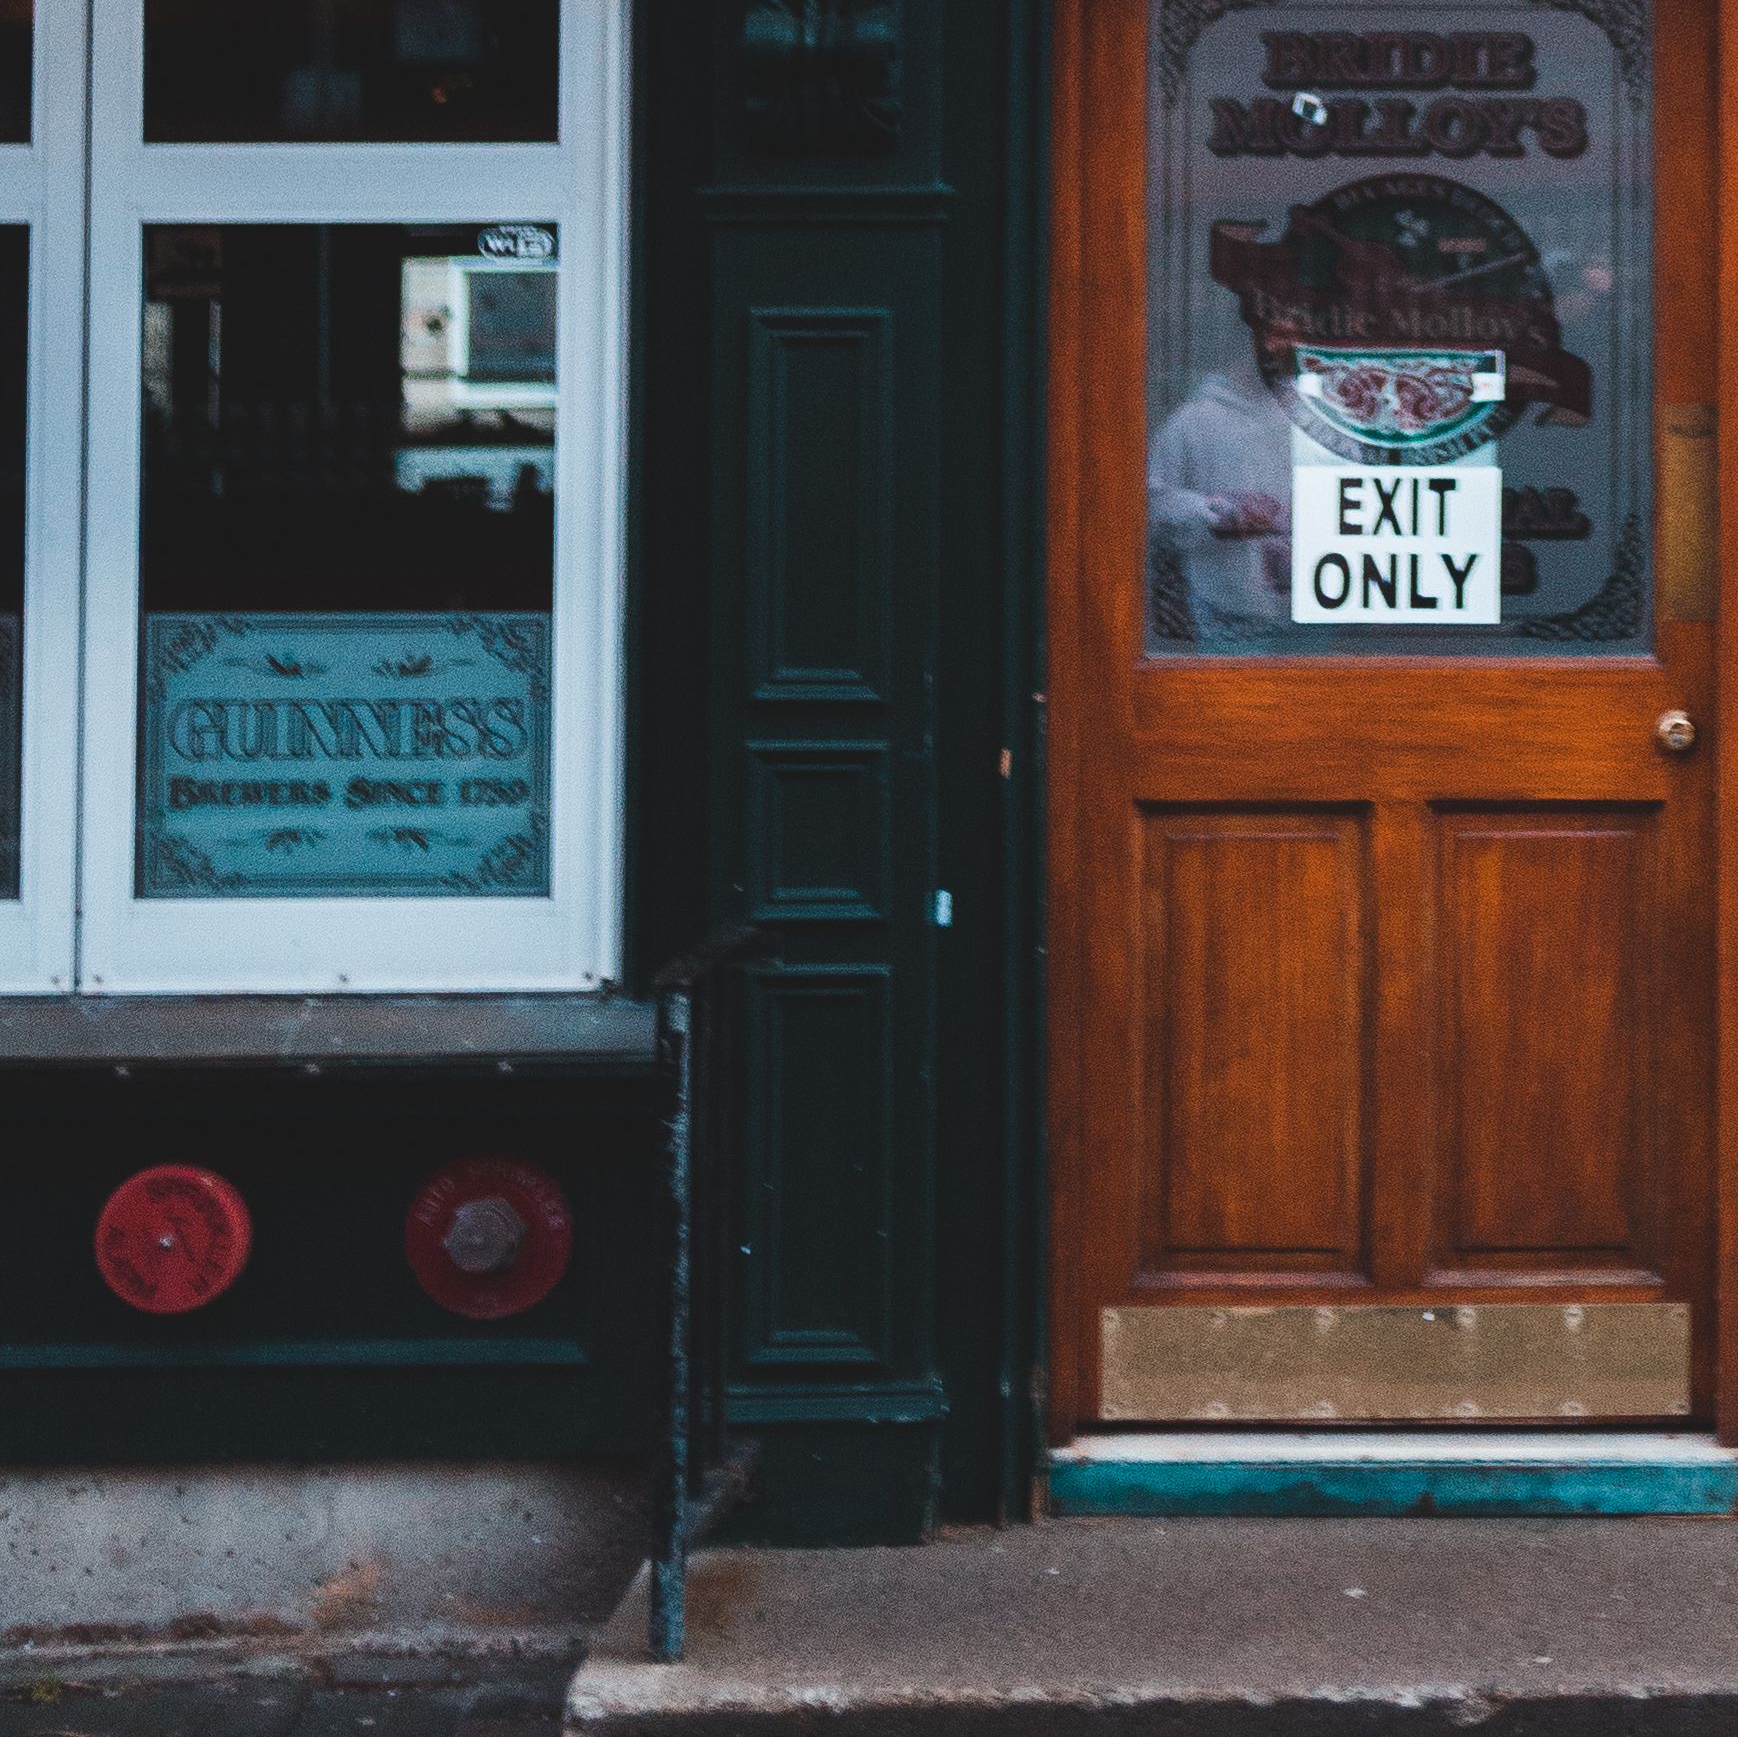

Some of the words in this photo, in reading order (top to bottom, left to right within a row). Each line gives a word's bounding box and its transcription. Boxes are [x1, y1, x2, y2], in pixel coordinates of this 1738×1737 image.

[1259, 29, 1537, 90] BRIDIE
[1338, 477, 1460, 537] EXIT
[1313, 551, 1479, 612] ONLY
[168, 696, 529, 763] GUINNESS
